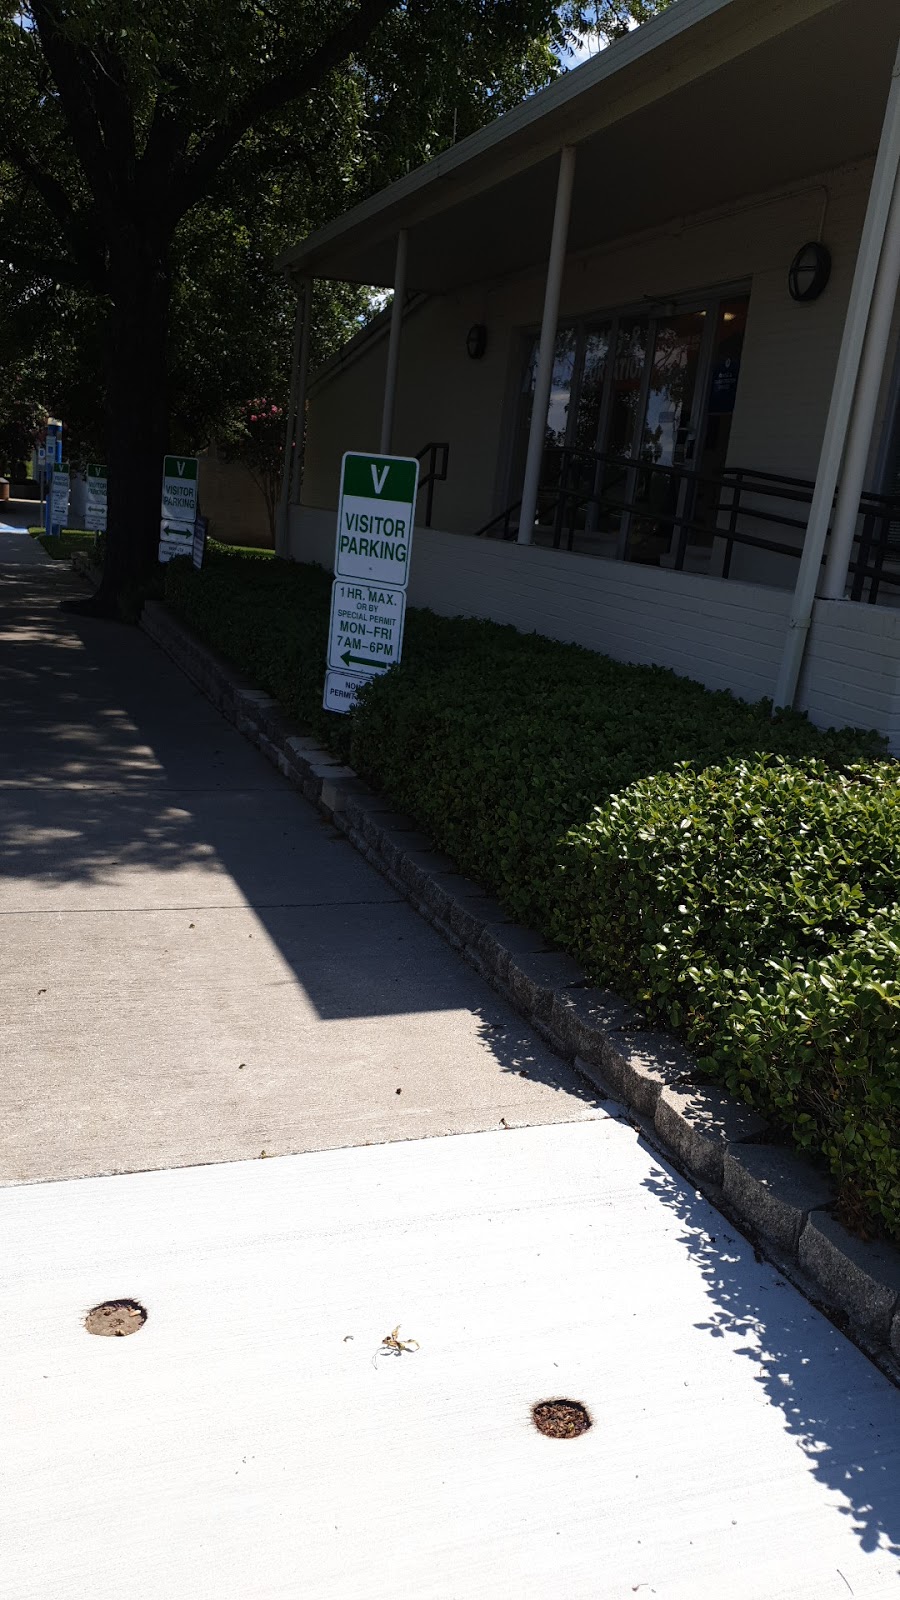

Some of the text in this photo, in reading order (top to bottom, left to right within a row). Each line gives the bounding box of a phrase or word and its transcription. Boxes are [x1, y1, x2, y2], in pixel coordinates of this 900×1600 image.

[59, 464, 64, 472] V
[95, 467, 101, 476] V
[176, 461, 186, 476] V
[370, 464, 391, 494] V
[166, 484, 194, 497] VISITOR
[163, 496, 195, 509] PARKING
[345, 512, 406, 538] VISITOR
[340, 535, 407, 562] PARKING
[340, 587, 397, 606] 1 HR. MAX.
[356, 602, 379, 612] OR BY
[337, 609, 397, 626] SPECIAL PERMIT
